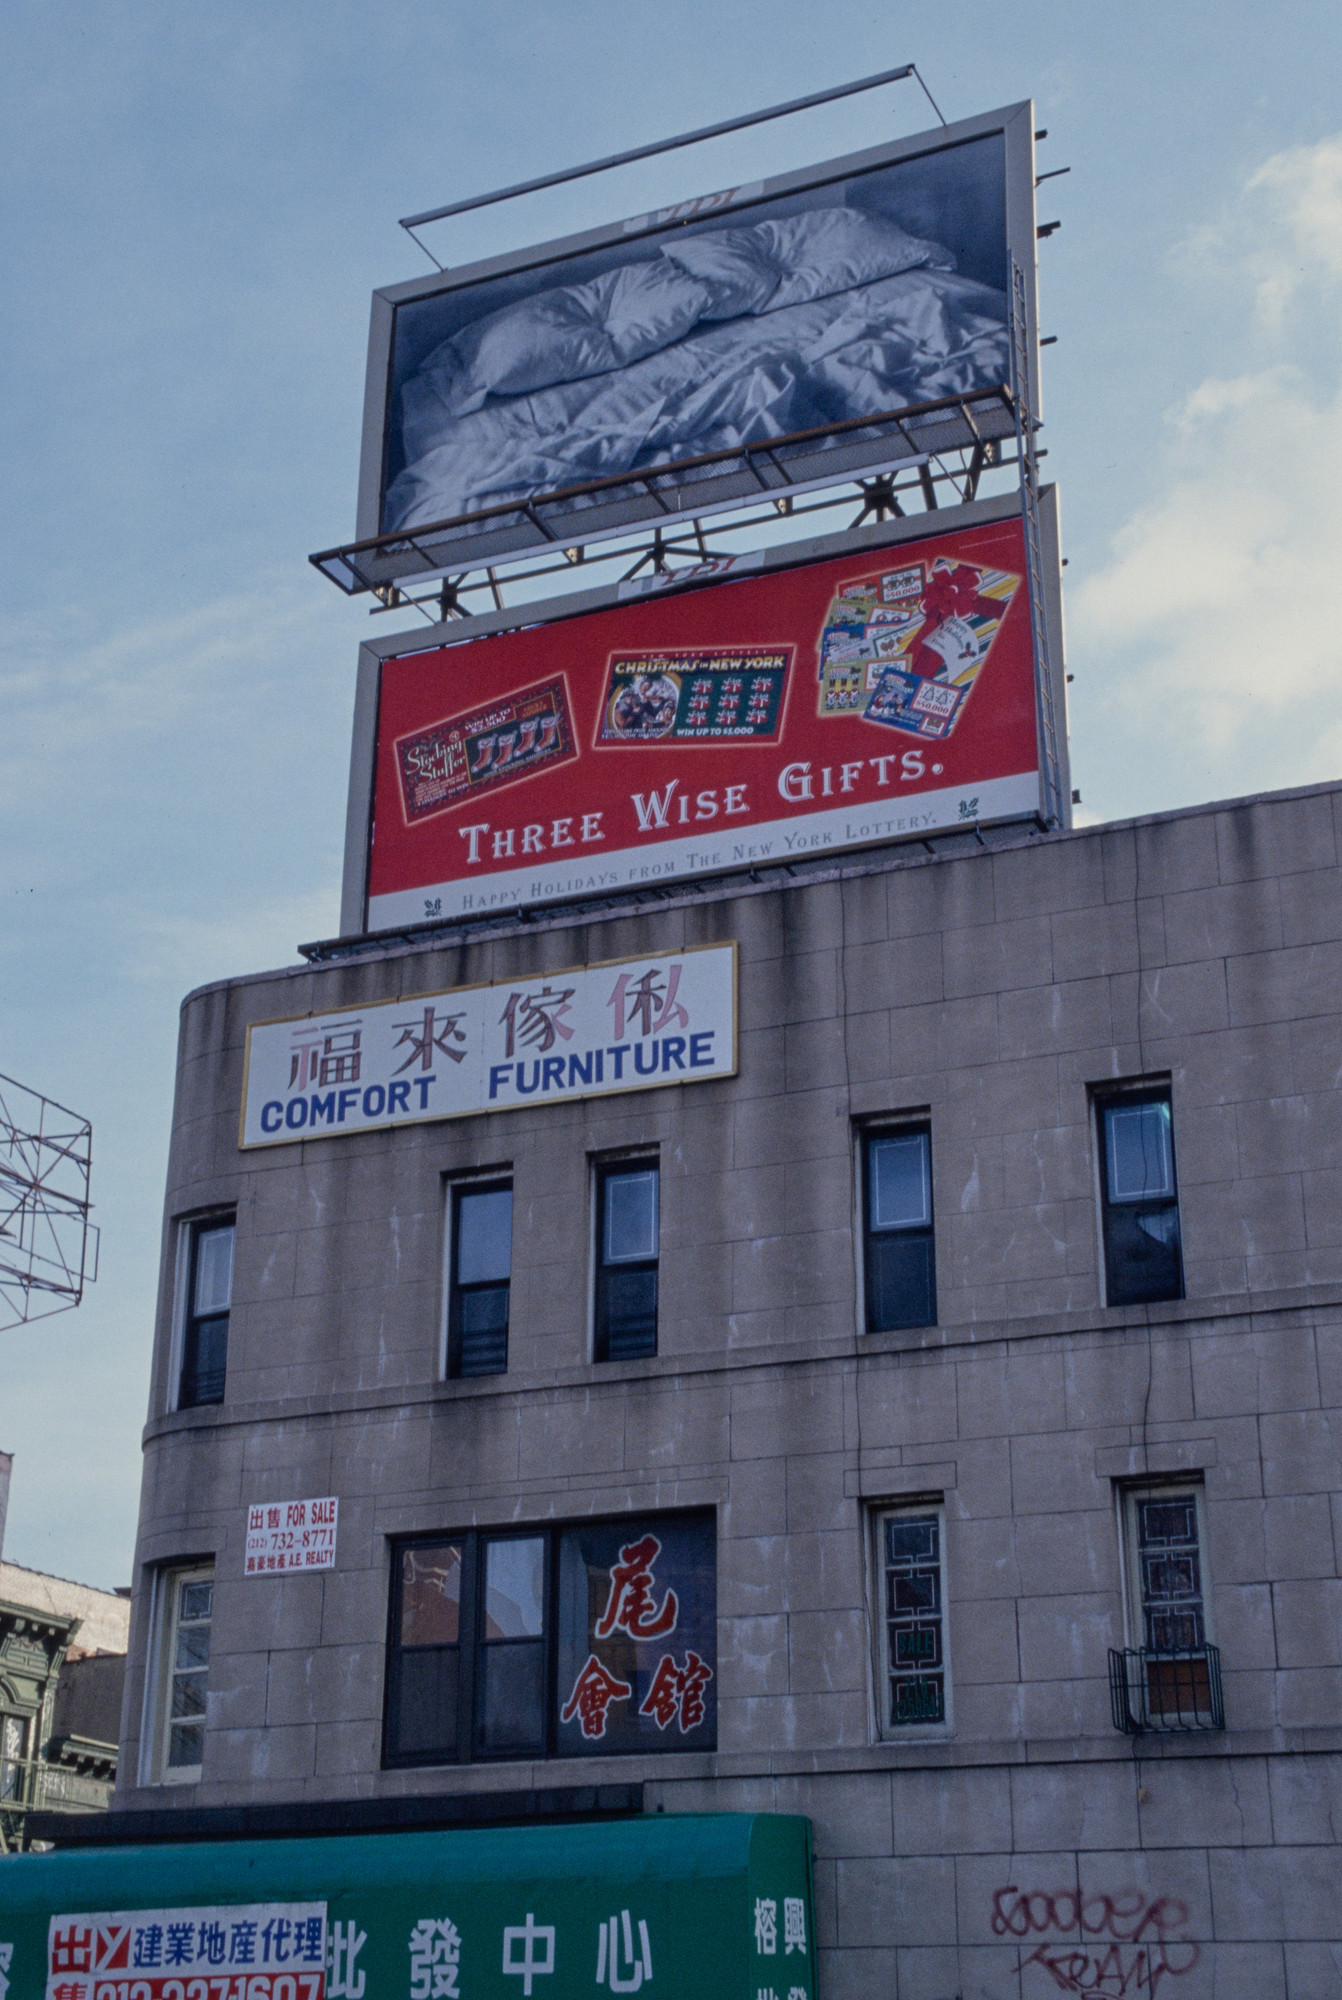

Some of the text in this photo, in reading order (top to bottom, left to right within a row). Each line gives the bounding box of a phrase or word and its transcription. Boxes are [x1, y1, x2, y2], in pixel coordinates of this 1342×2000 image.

[614, 659, 700, 674] CHRISTMAS
[709, 657, 743, 671] NEW
[744, 655, 785, 670] YORK
[464, 719, 484, 731] WIN
[485, 713, 497, 723] UP
[499, 708, 511, 716] TO
[677, 728, 695, 736] WIN
[696, 728, 708, 736] UP
[709, 727, 722, 736] TO
[722, 726, 754, 736] $5,000
[406, 738, 463, 775] Stocking
[416, 753, 466, 784] Stuffer
[459, 750, 944, 865] THREE WISE GIFTS.
[463, 811, 937, 910] HAPPY HOLIDAYS FROM THE NEW YORK LOTTERY.
[286, 964, 690, 1091] 福來傢俬
[260, 1031, 716, 1133] COMFORT FURNITURE
[250, 1501, 335, 1531] 出售 FOR SALE
[247, 1529, 334, 1551] (212) 732-8771
[289, 1552, 303, 1567] A.E.
[306, 1549, 334, 1566] REALTY
[595, 1533, 679, 1641] 尾
[899, 1631, 933, 1655] SALE
